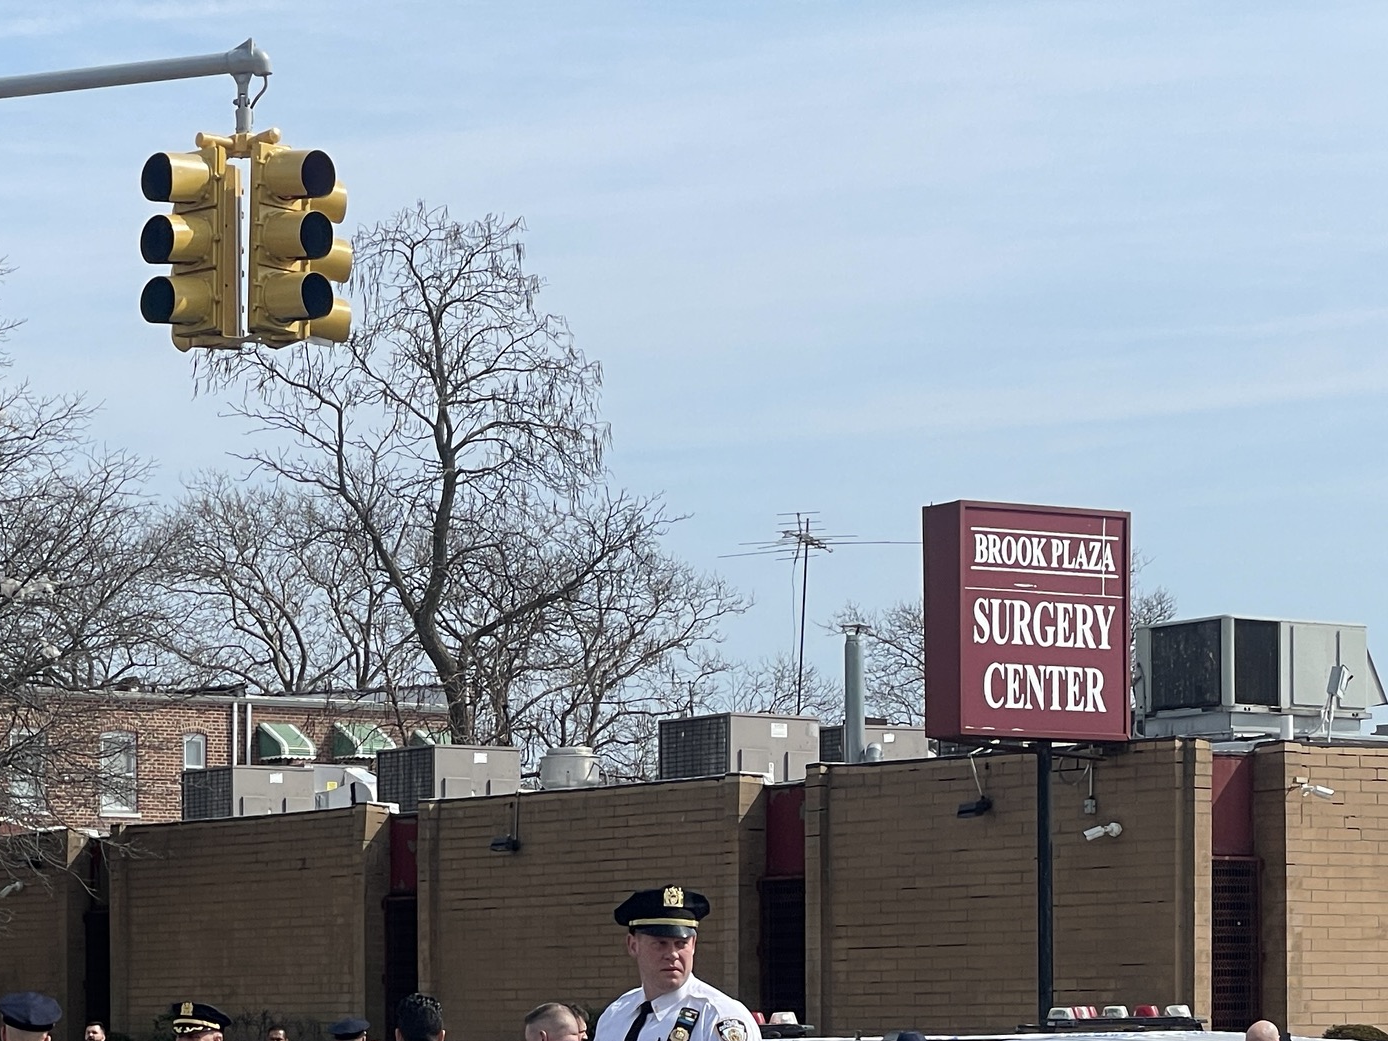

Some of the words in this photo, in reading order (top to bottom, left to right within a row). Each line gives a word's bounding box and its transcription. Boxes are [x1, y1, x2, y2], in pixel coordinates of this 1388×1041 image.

[974, 534, 1048, 567] BROOK
[1050, 539, 1116, 571] PLAZA
[973, 597, 1116, 650] SURGERY
[983, 662, 1107, 713] CENTER
